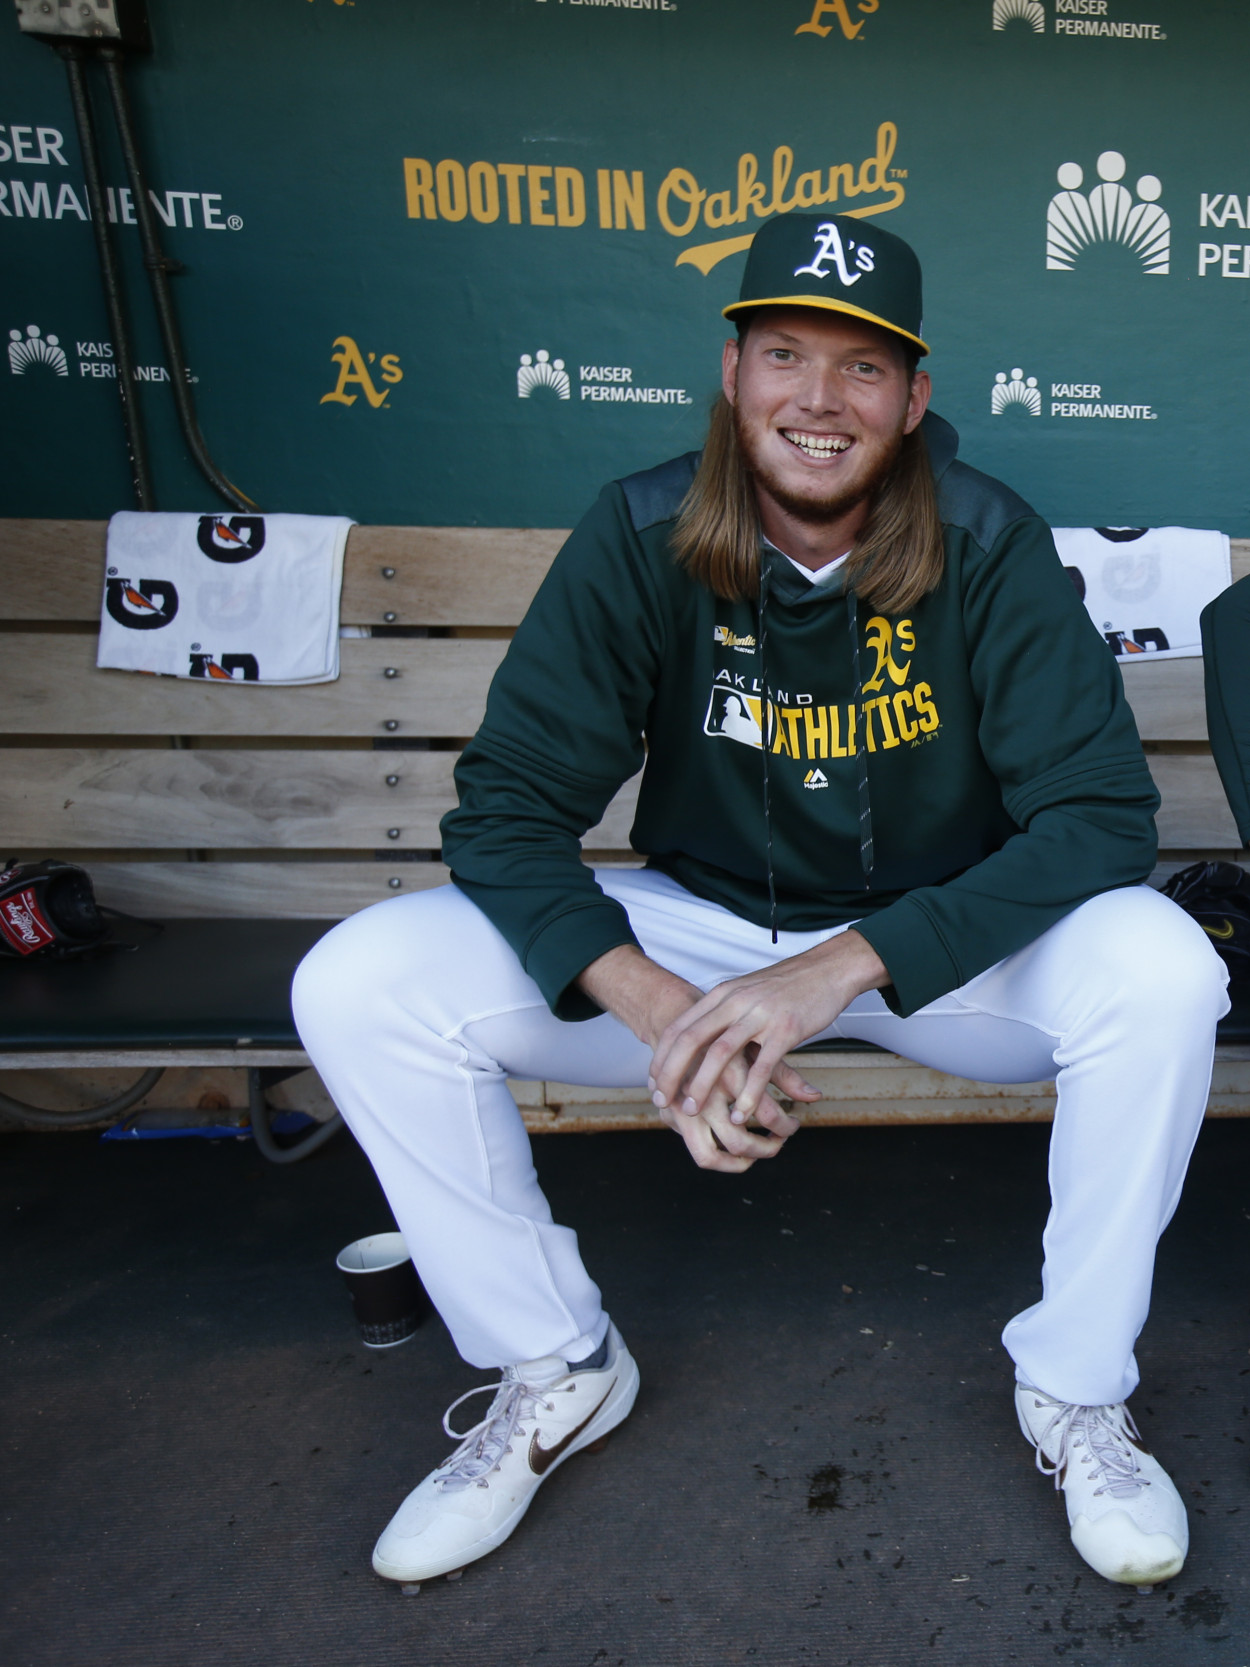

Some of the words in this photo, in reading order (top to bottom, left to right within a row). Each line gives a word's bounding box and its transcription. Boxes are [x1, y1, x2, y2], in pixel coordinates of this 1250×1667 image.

[1056, 0, 1108, 15] KAISER
[404, 158, 586, 228] ROOTED
[597, 168, 646, 231] IN
[657, 121, 904, 237] Oakland
[793, 222, 875, 286] A's
[320, 336, 403, 408] A's
[580, 366, 632, 383] KAISER
[581, 386, 688, 405] PERMANENTE
[1052, 384, 1101, 399] KAISER
[1052, 402, 1154, 420] PERMANENTE
[772, 681, 940, 760] ATHLETICS
